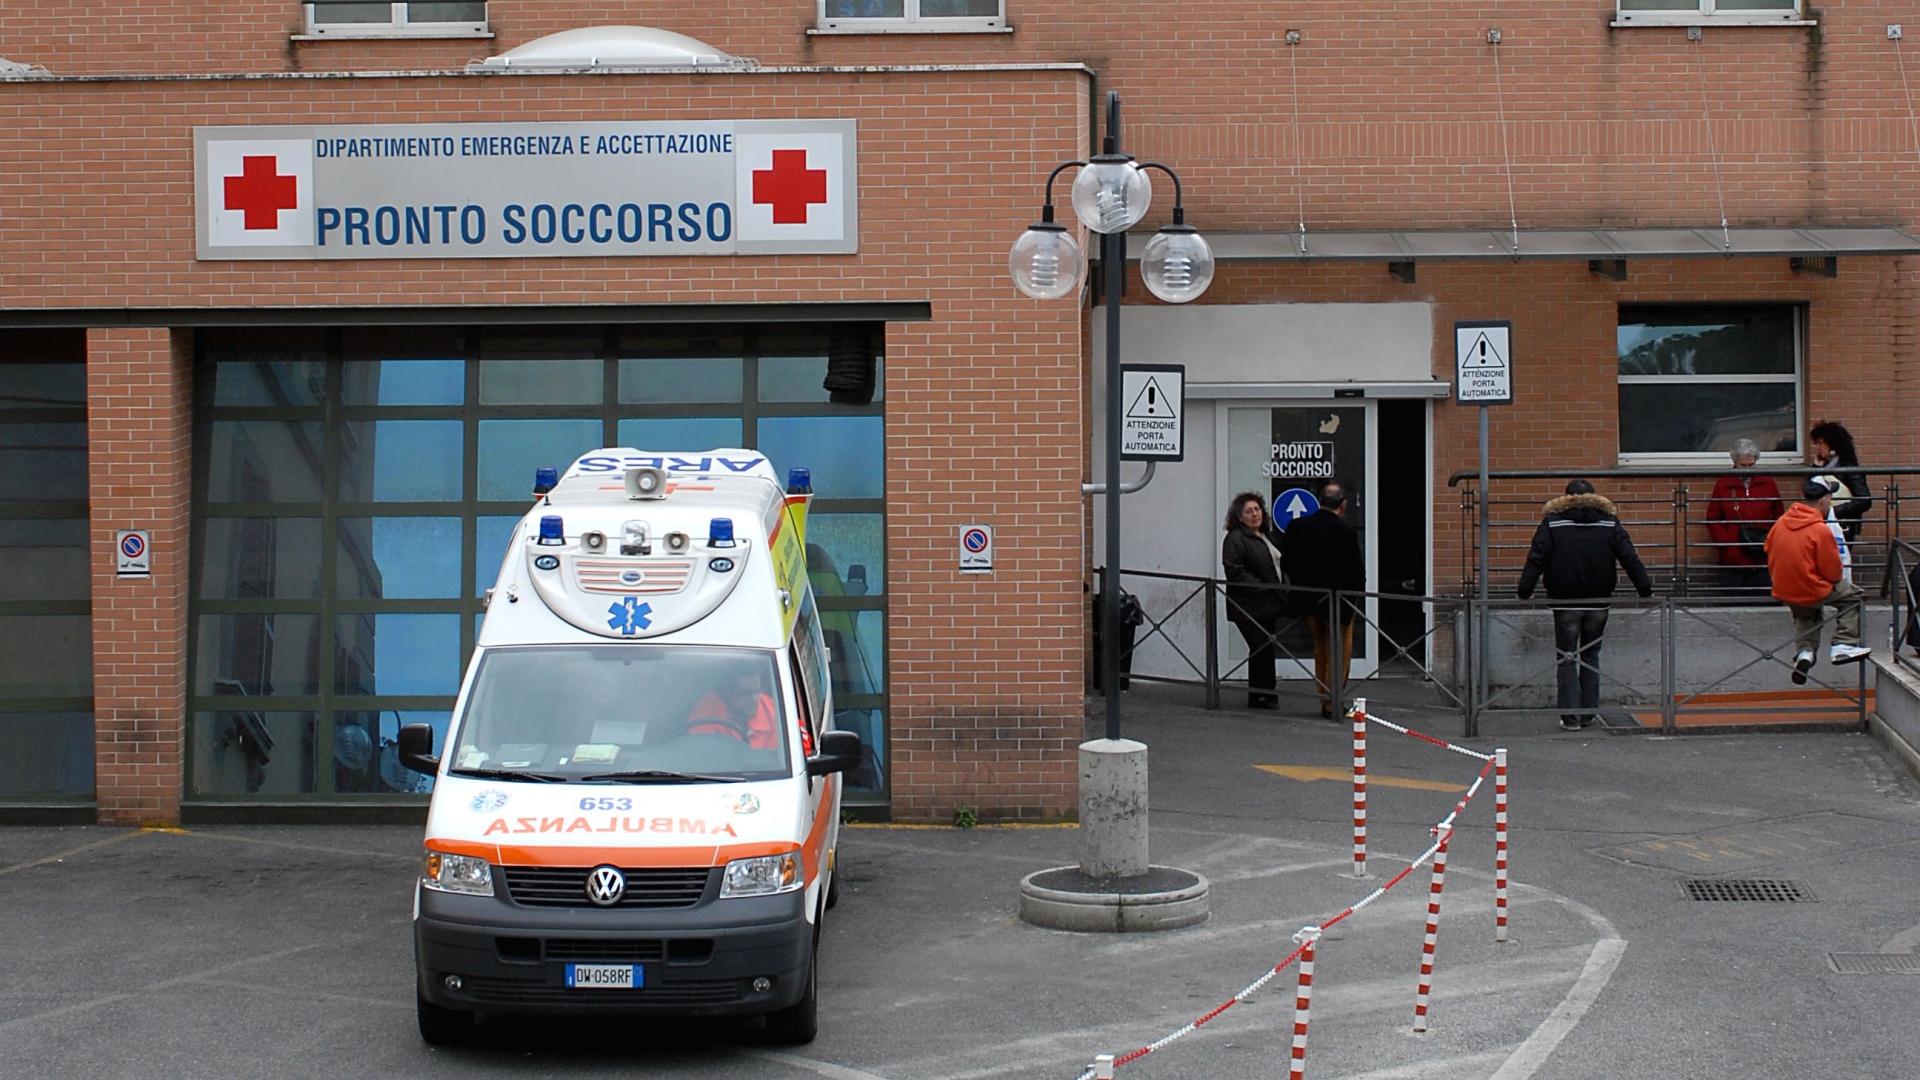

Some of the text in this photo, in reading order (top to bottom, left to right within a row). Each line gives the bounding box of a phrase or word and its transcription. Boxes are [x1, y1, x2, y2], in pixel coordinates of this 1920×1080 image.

[316, 134, 732, 157] DIPARTIMENTO EMERGENZA E ACCETTAZIONE
[317, 202, 732, 246] PRONTO SOCCORSO
[1462, 370, 1505, 378] ATTENZIONE
[1462, 389, 1506, 397] AUTOMATICA
[1126, 421, 1176, 430] ATTENZIONE
[1137, 431, 1164, 440] PORTA
[1125, 442, 1176, 451] AUTOMATICA
[1271, 443, 1324, 459] PRONTO
[578, 457, 766, 472] ARES
[1262, 461, 1332, 476] SOCCORSO
[579, 797, 633, 811] 653
